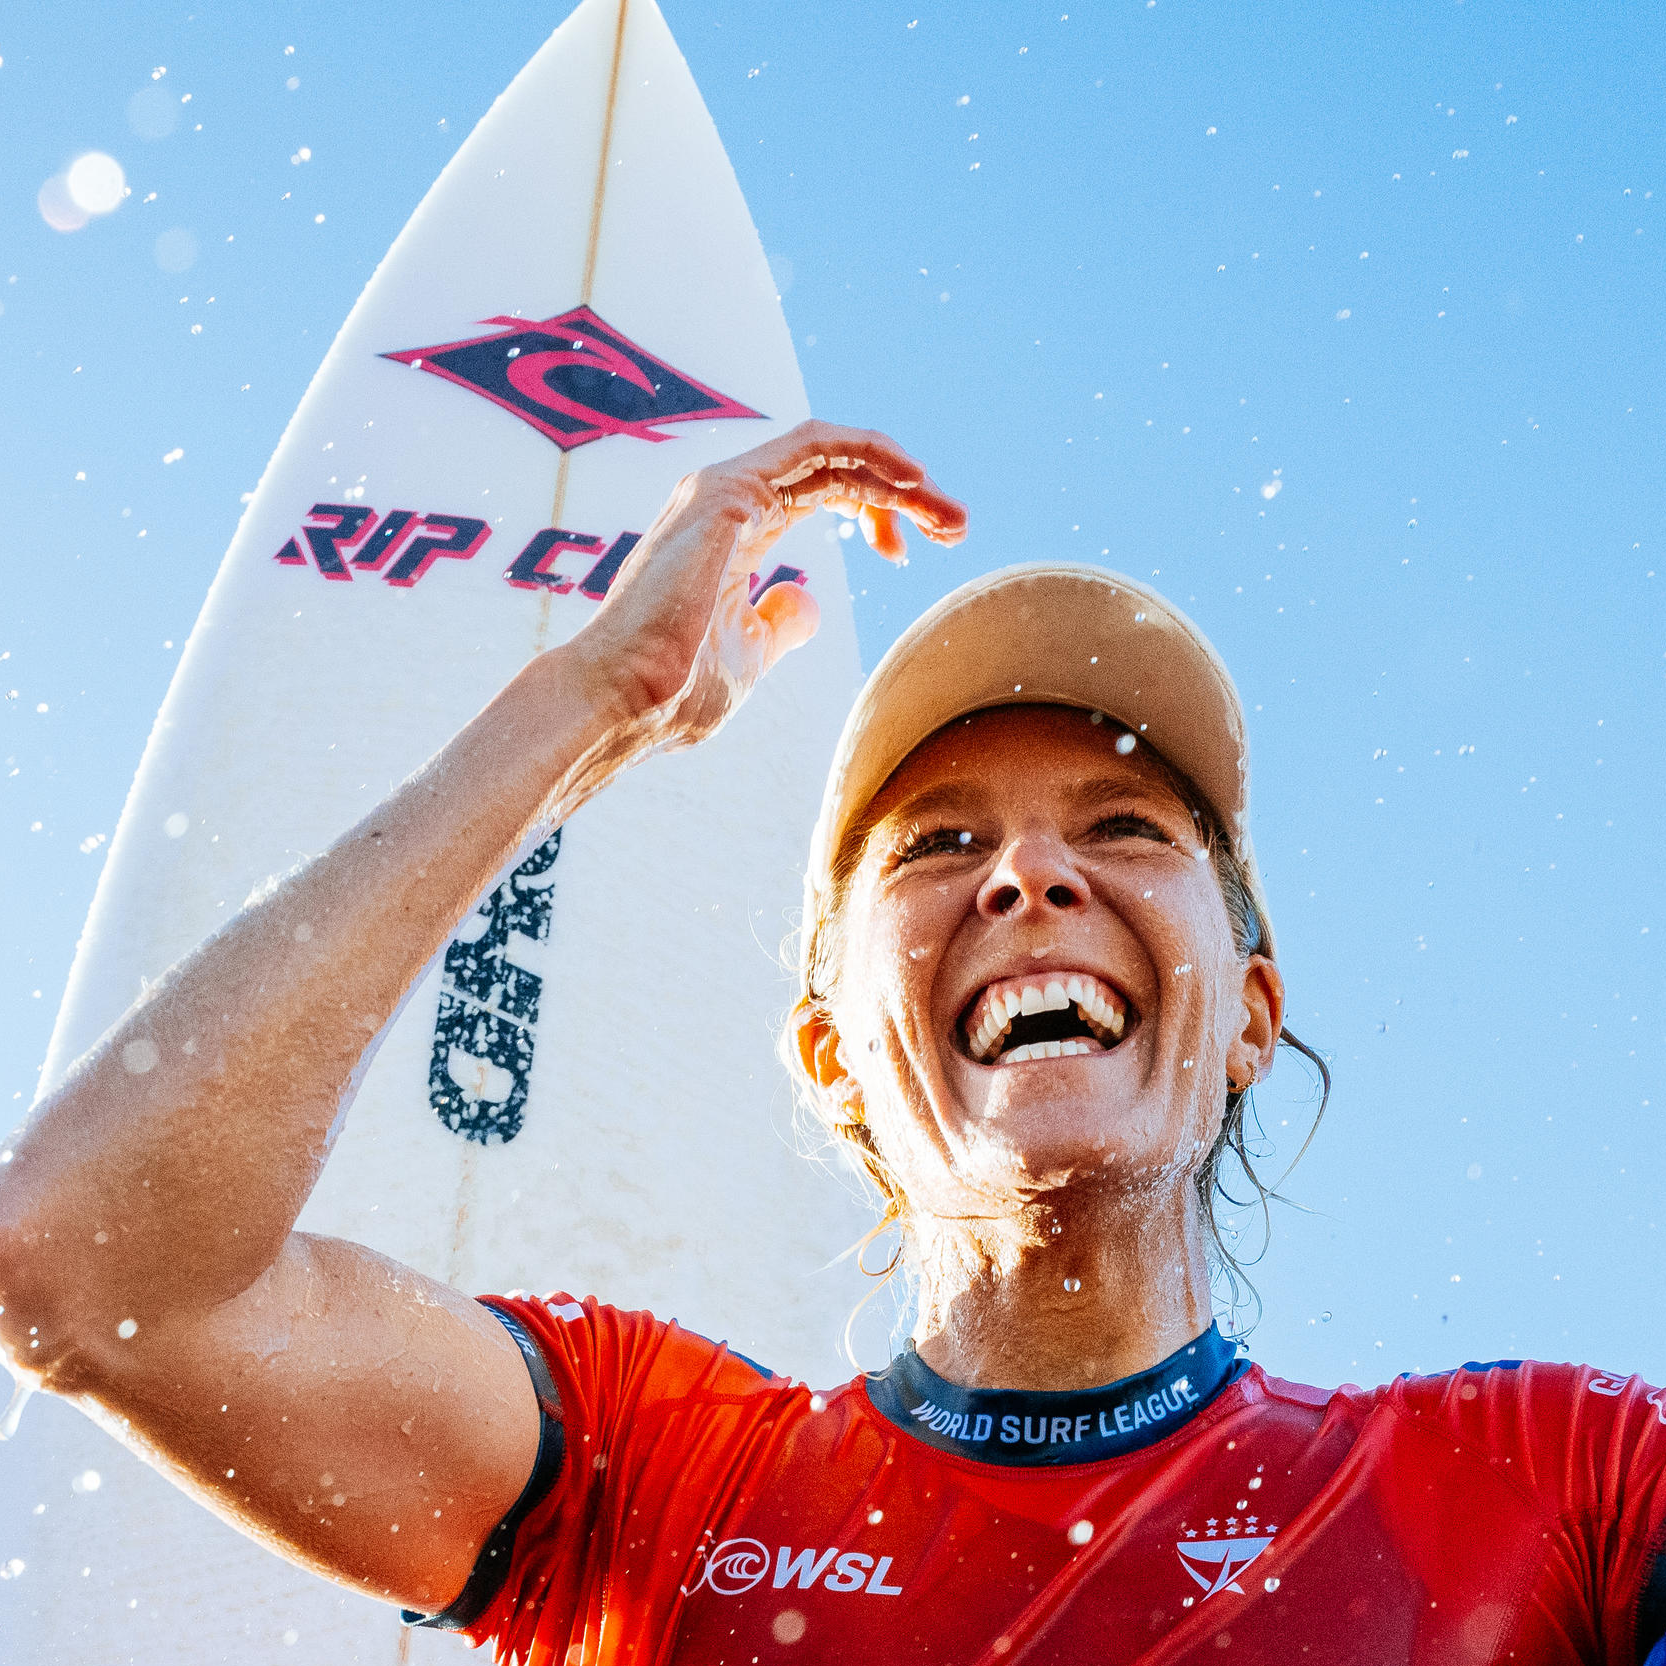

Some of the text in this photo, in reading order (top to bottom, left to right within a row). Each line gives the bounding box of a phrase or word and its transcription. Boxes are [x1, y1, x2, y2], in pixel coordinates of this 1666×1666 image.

[274, 503, 493, 589] RIP
[428, 826, 563, 1146] HD
[909, 1374, 1200, 1445] WORLD SURF LEAGUE
[772, 1546, 904, 1596] WSL
